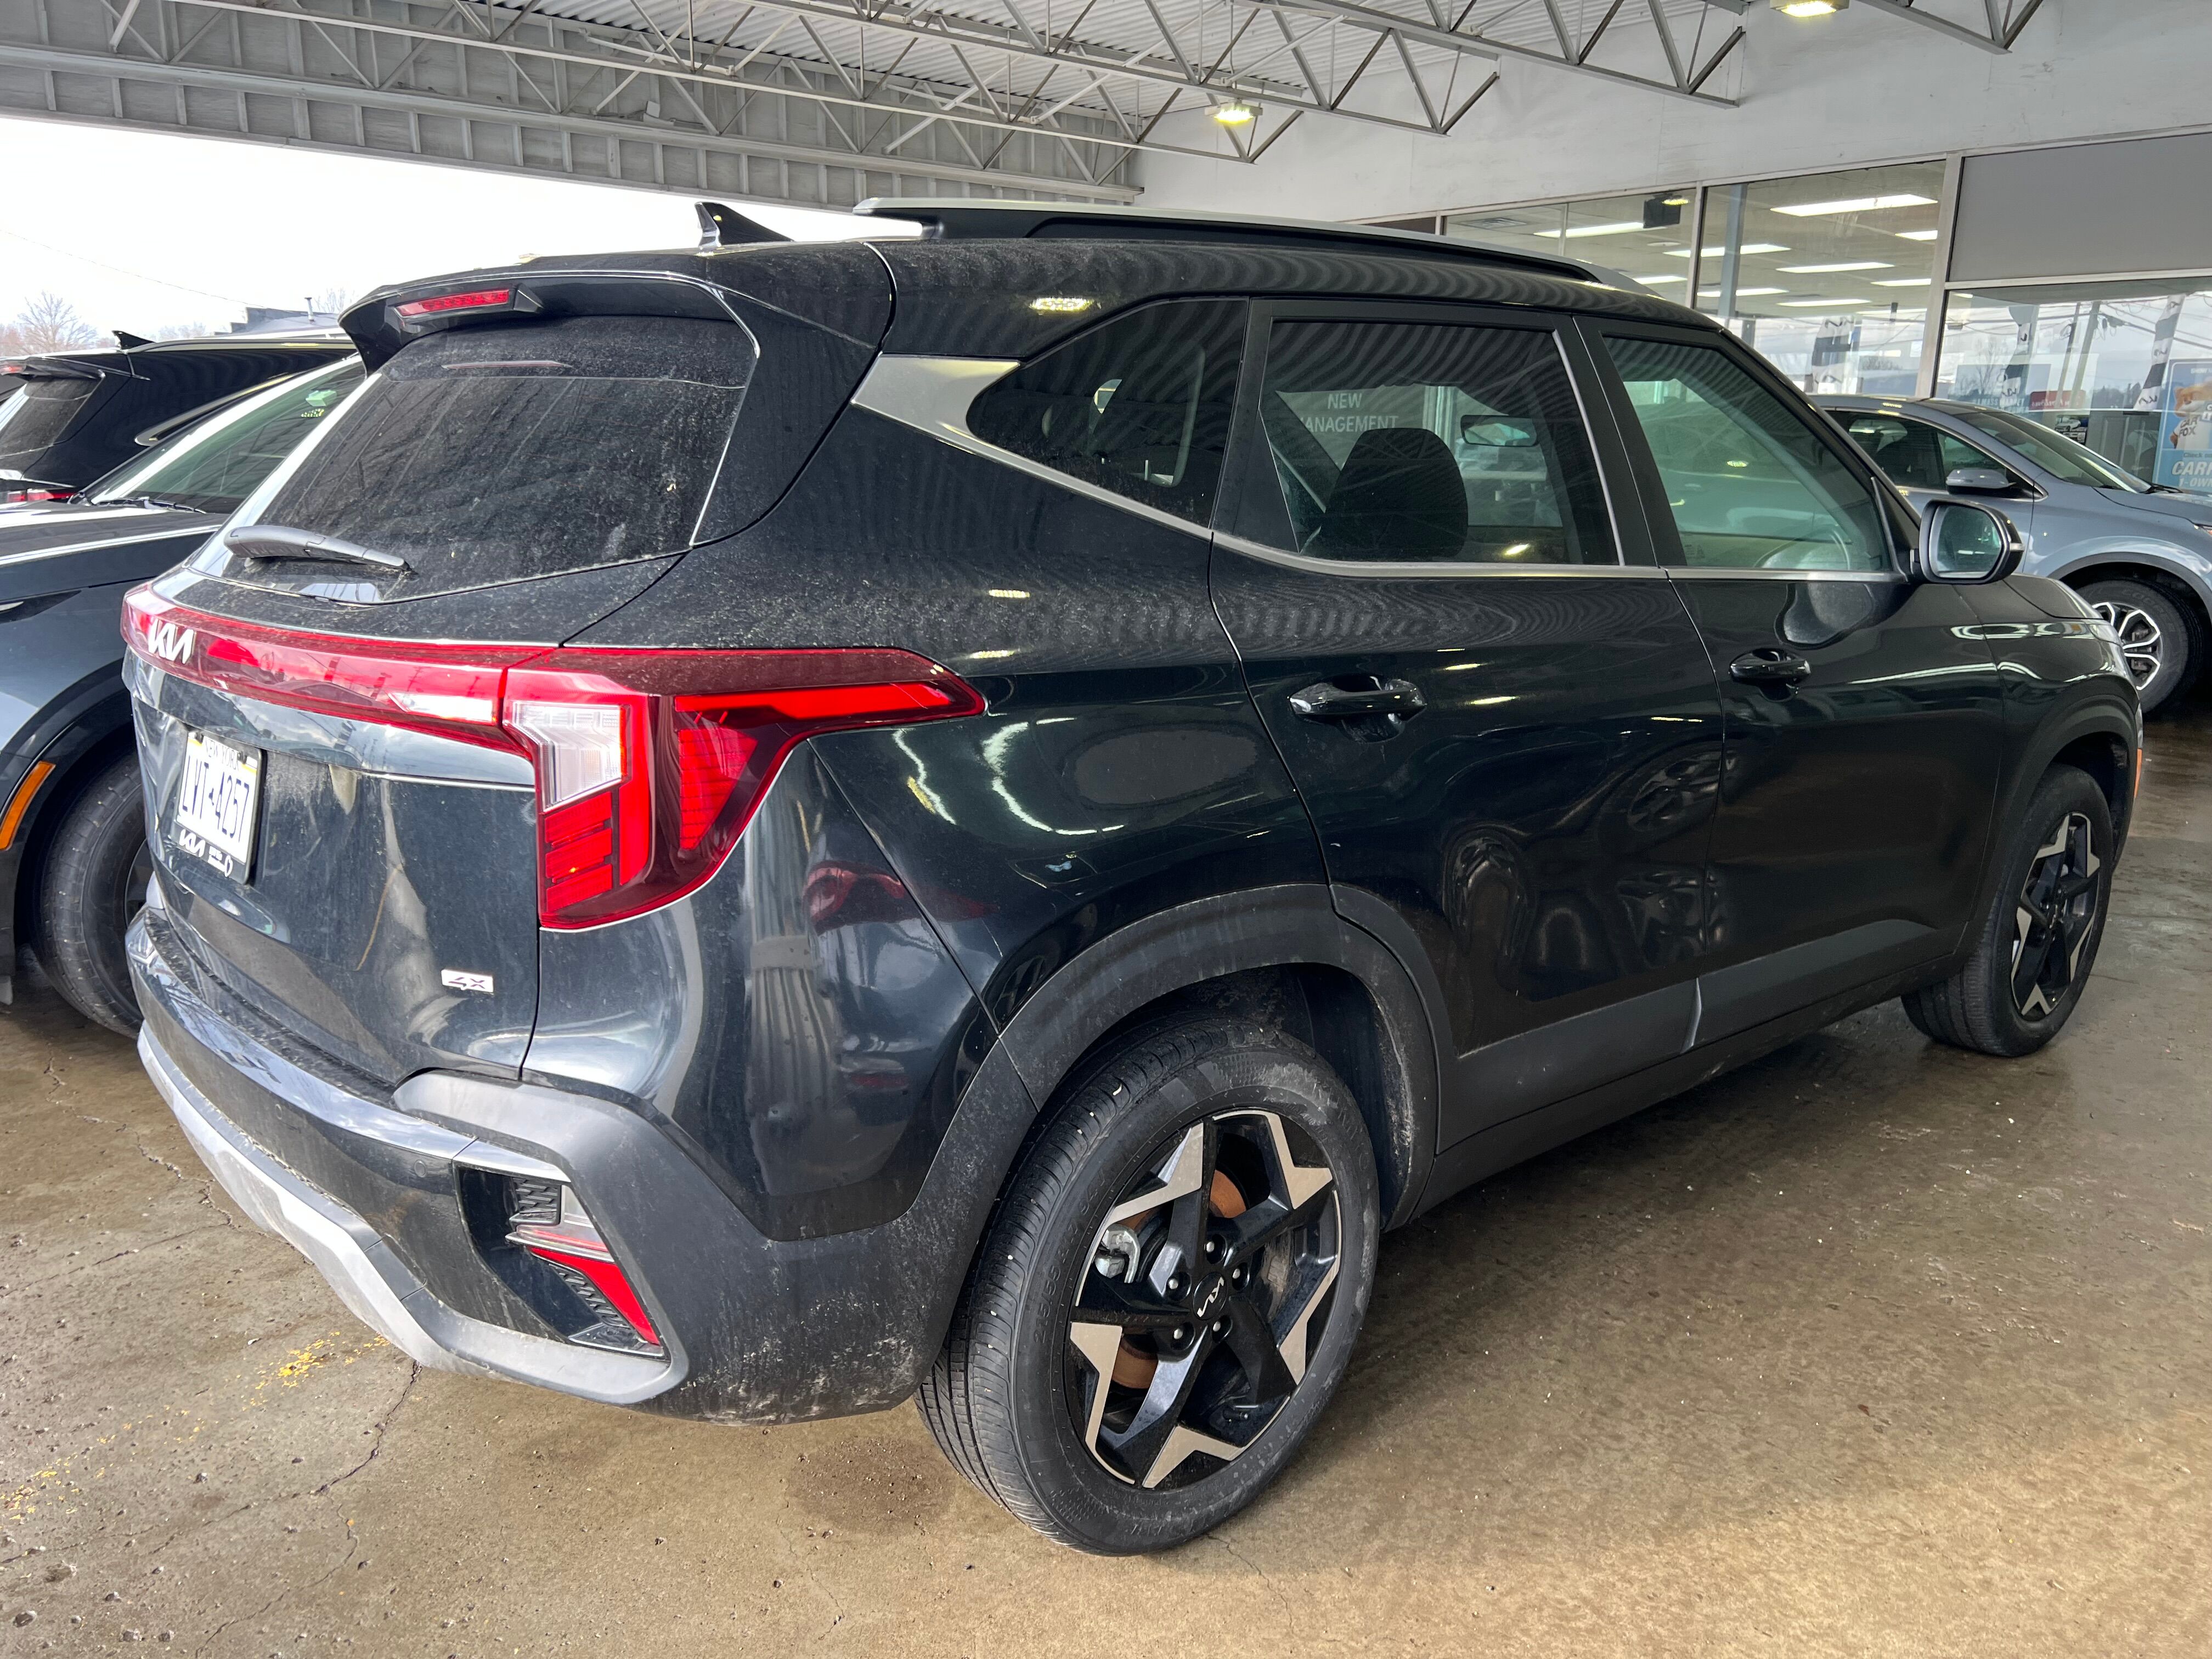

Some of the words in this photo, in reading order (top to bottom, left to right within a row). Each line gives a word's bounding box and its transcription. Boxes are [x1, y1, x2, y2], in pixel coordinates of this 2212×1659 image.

[1328, 393, 1362, 409] NEW
[1300, 415, 1398, 432] ANAGEMENT
[2179, 426, 2196, 437] FOX
[148, 619, 195, 664] KIA
[182, 754, 210, 819] LYT
[215, 771, 250, 843] 4257
[179, 829, 206, 857] KIA
[1197, 1277, 1224, 1317] KIA
